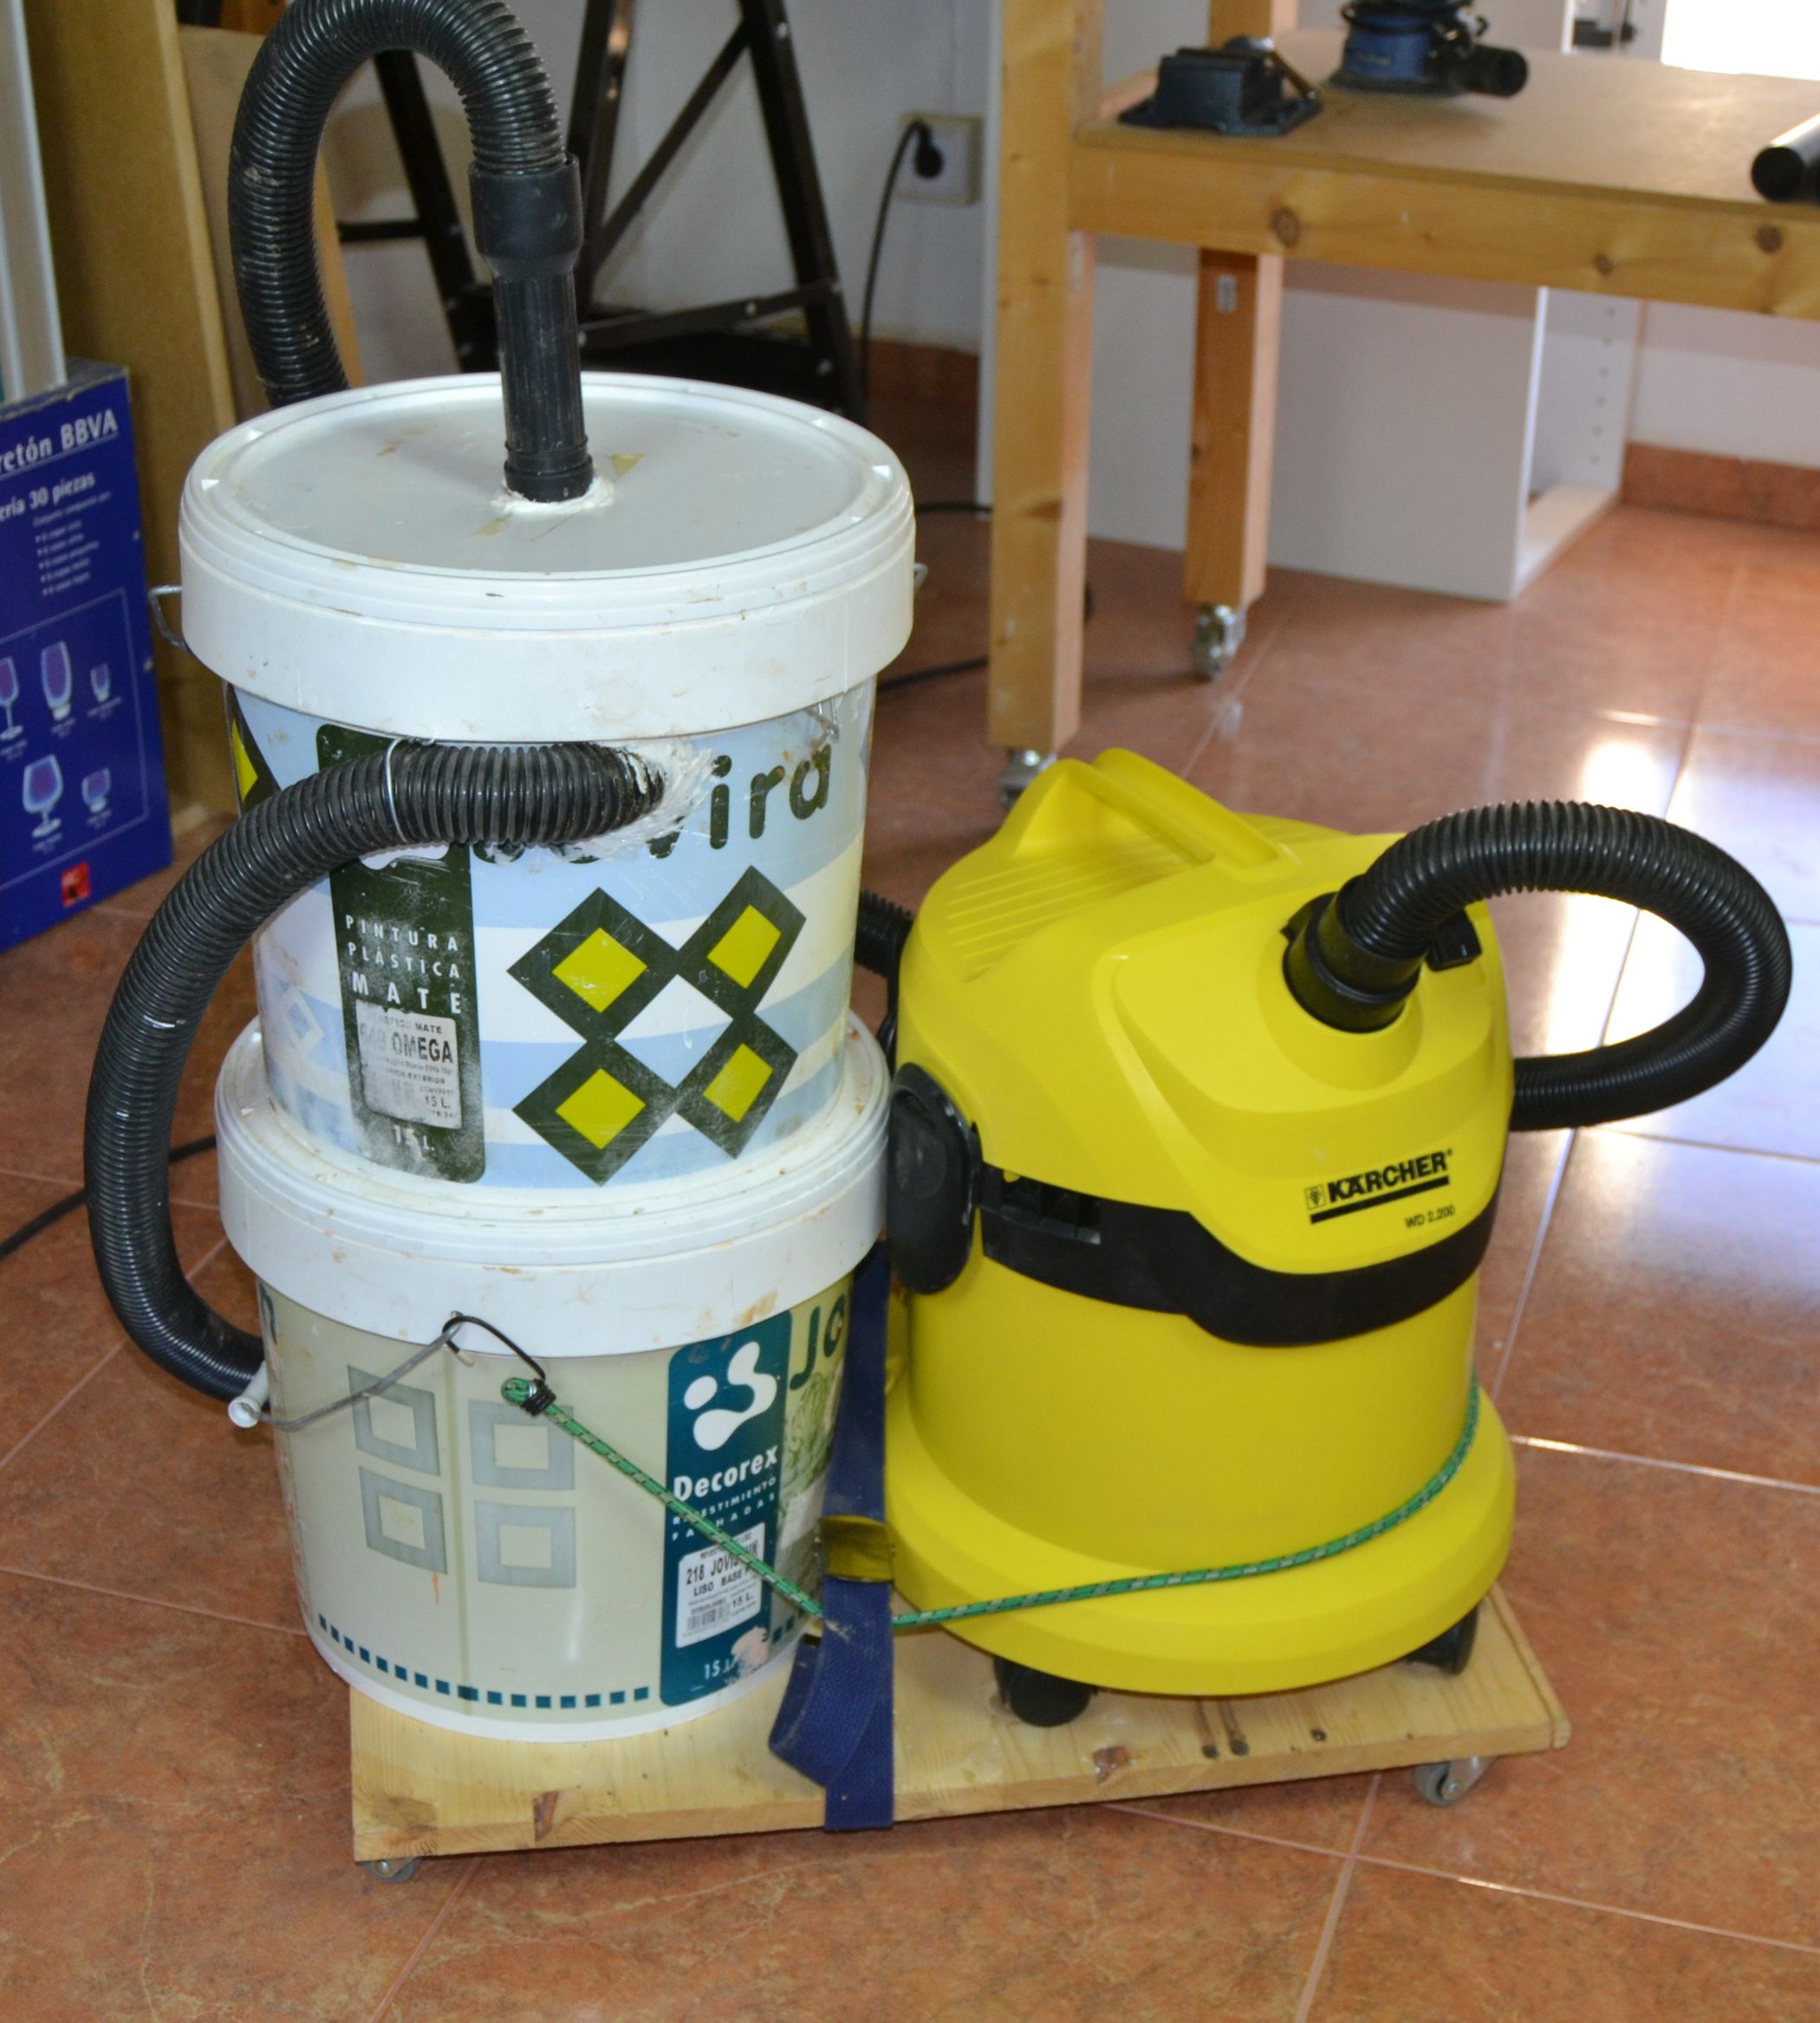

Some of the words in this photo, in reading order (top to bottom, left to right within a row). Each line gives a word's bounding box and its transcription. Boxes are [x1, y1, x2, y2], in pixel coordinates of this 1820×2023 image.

[0, 434, 52, 472] ctón
[61, 408, 118, 451] BBVA
[29, 487, 49, 510] 30
[52, 472, 96, 505] piezas
[346, 914, 458, 952] PINTURA
[348, 941, 459, 979] PLÁSTICA
[352, 971, 461, 1014] MATE
[415, 1023, 442, 1034] MATE
[392, 1031, 453, 1064] OMEGA
[426, 1096, 437, 1108] 15
[1405, 1214, 1425, 1229] WD
[1427, 1204, 1456, 1223] 2.200
[673, 1445, 778, 1502] Decorex
[672, 1492, 775, 1541] FAHADAS
[686, 1563, 705, 1585] 218
[693, 1582, 714, 1597] LISO
[721, 1569, 743, 1587] BASE
[704, 1659, 720, 1681] 15
